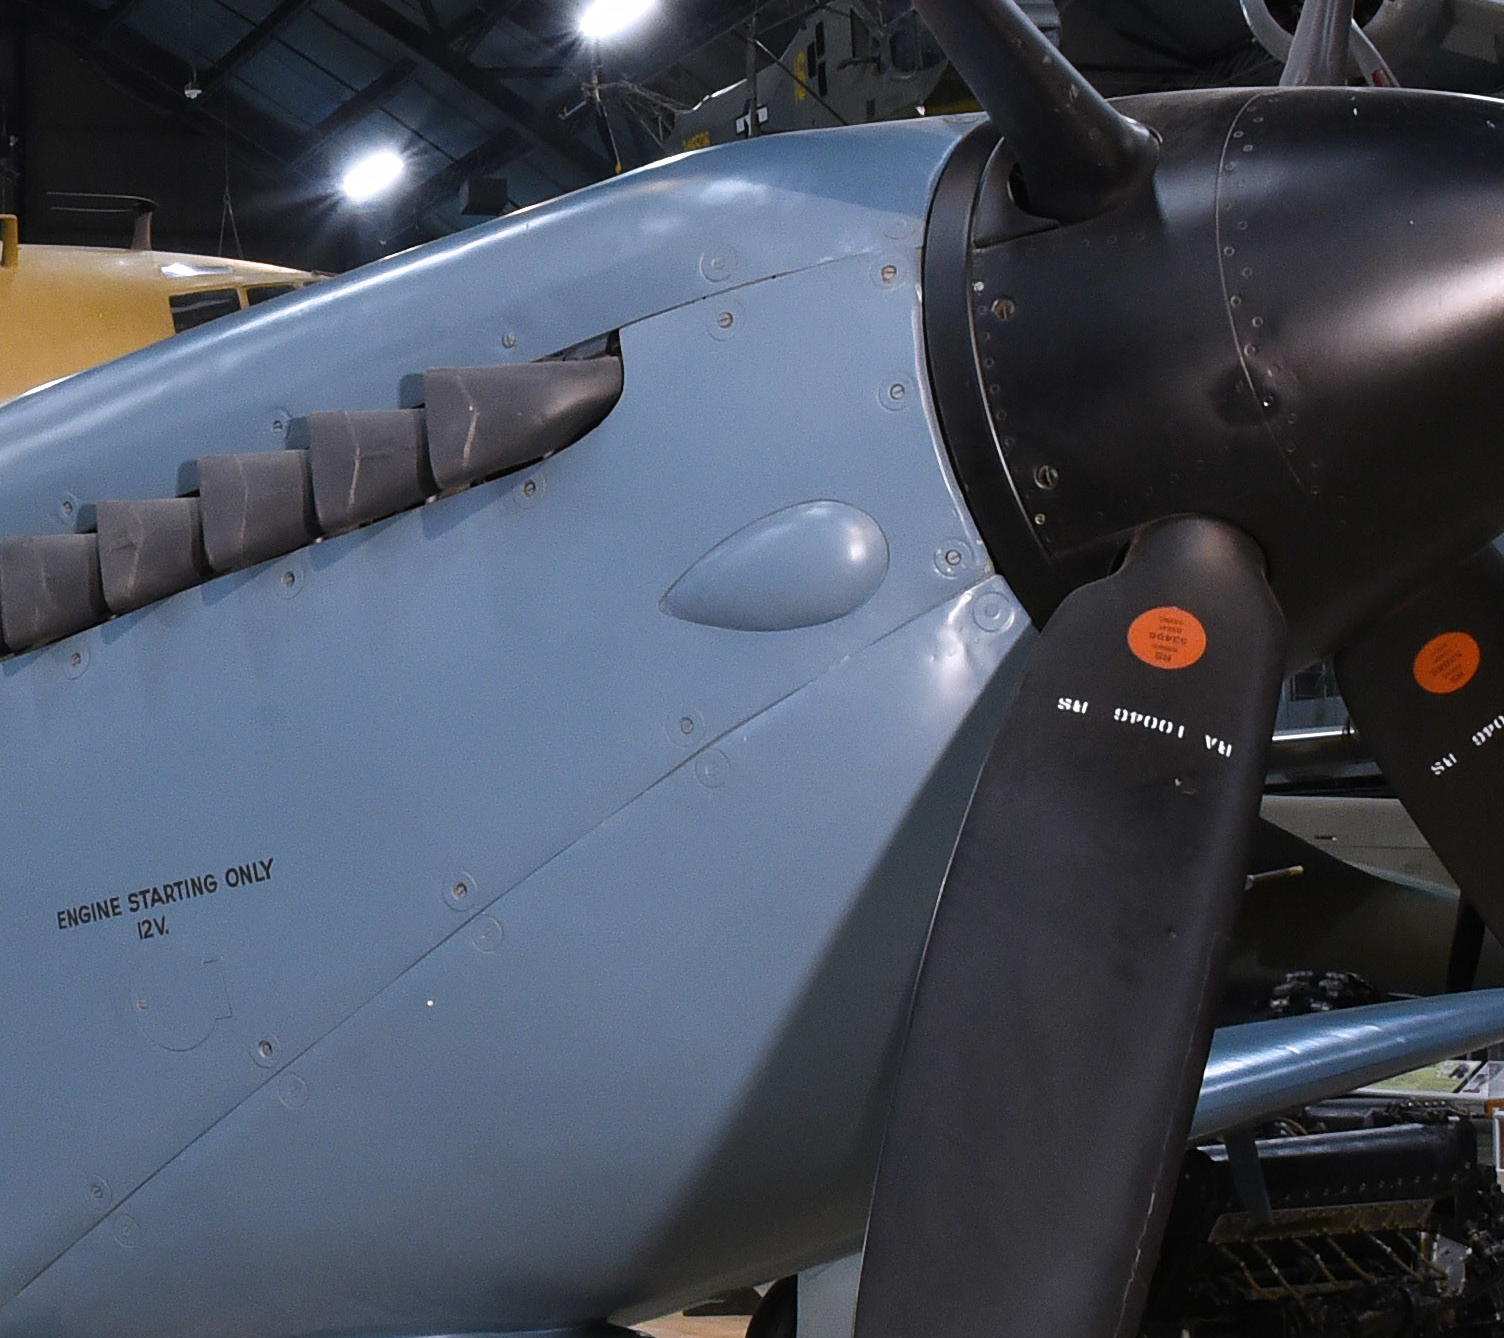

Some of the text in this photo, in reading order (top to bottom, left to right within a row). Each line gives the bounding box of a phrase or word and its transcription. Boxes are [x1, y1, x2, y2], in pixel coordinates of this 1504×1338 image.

[1113, 707, 1185, 739] 10046
[57, 857, 274, 929] ENGINE STARTING ONLY
